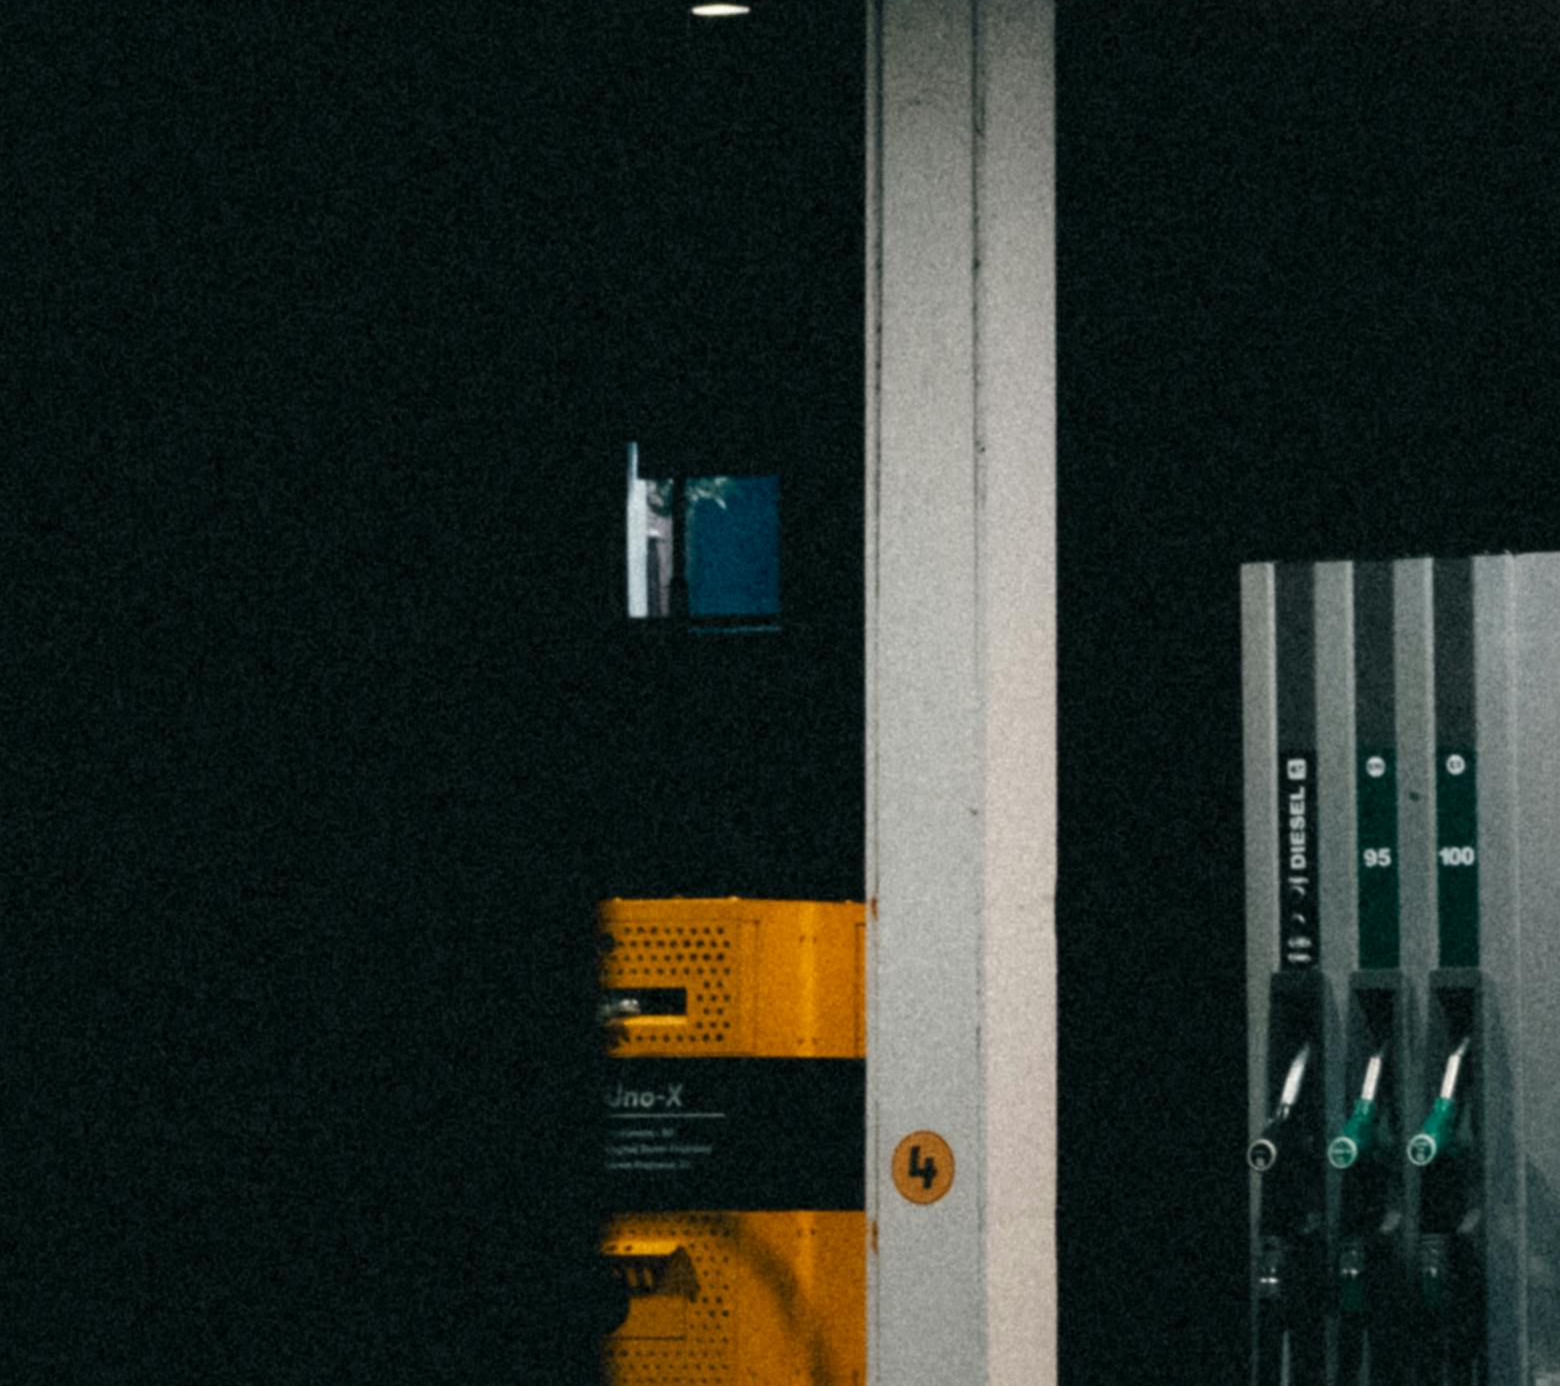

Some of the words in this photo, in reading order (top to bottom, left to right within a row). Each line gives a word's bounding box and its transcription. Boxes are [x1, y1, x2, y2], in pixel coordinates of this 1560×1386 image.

[1290, 786, 1307, 869] DIESEL
[1363, 848, 1391, 867] 95
[1439, 846, 1475, 866] 100
[908, 1144, 938, 1190] 4
